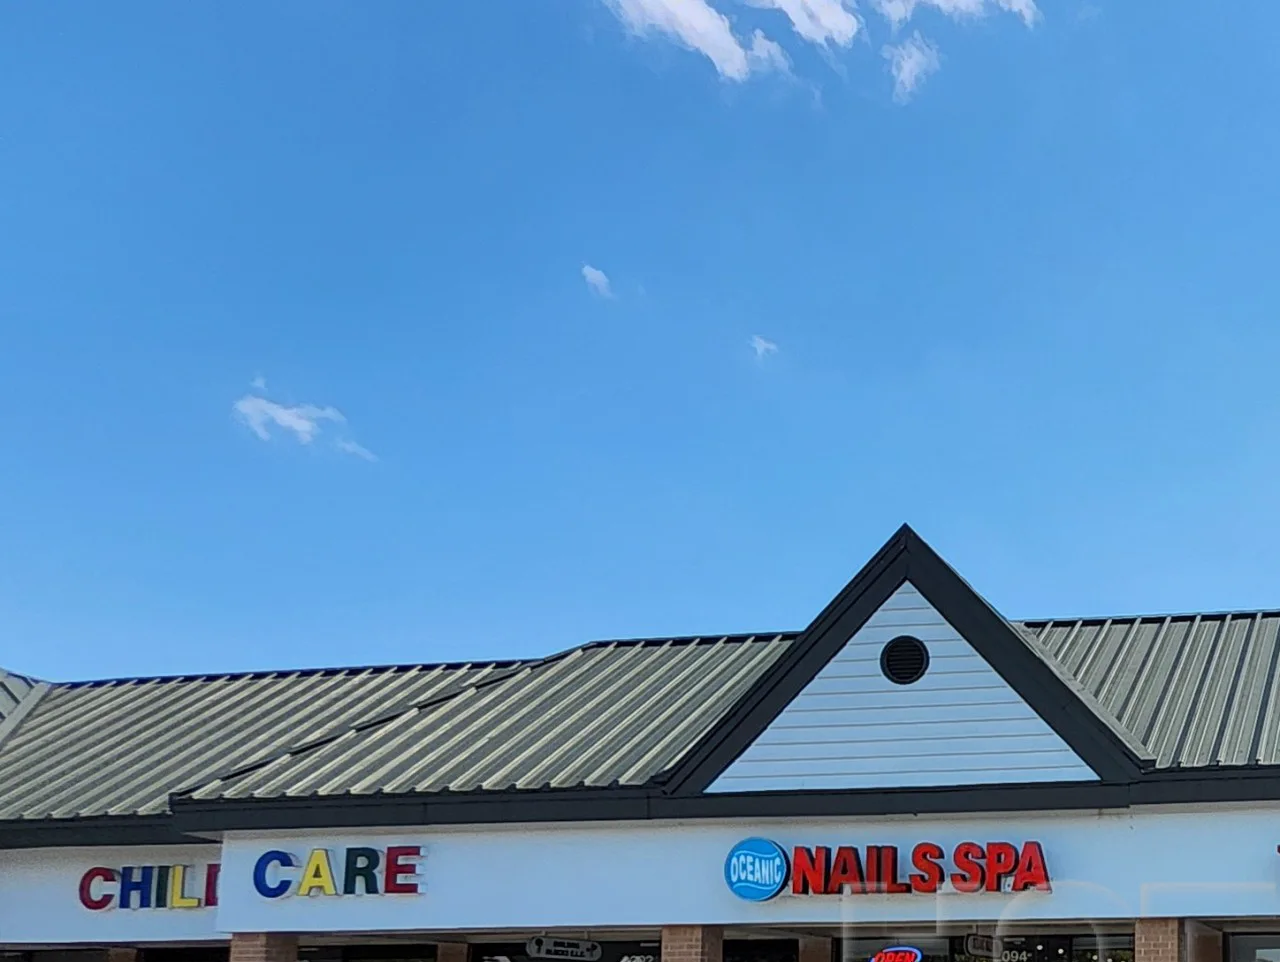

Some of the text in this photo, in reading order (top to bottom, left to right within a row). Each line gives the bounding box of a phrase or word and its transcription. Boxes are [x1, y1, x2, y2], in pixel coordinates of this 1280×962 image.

[253, 845, 428, 899] CARE
[730, 840, 1053, 895] OCEANIC NAILS SPA
